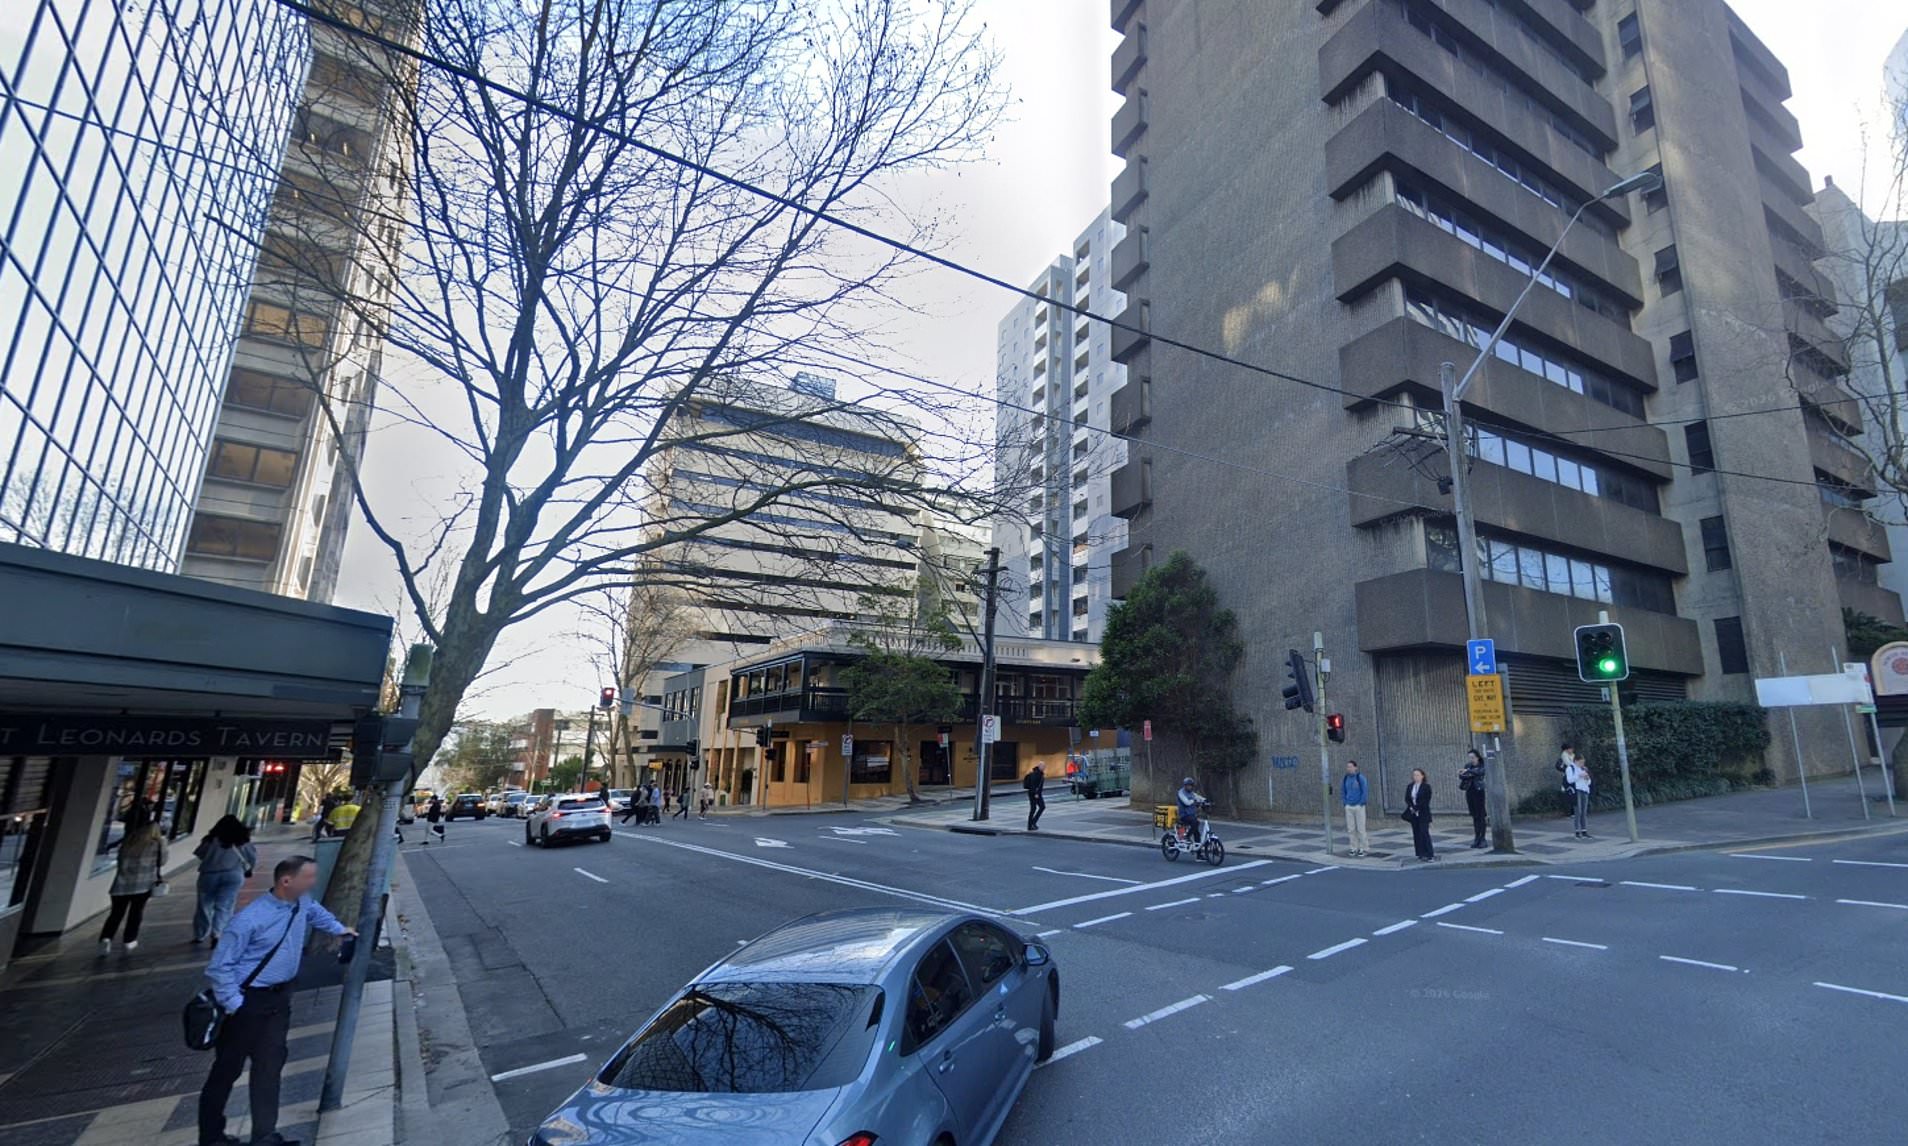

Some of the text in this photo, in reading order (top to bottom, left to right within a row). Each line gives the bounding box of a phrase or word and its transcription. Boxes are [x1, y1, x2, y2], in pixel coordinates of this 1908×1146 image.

[1475, 646, 1486, 659] P
[1472, 680, 1495, 688] LEFT
[36, 722, 201, 746] LEONARDS
[215, 726, 323, 748] TAVERN
